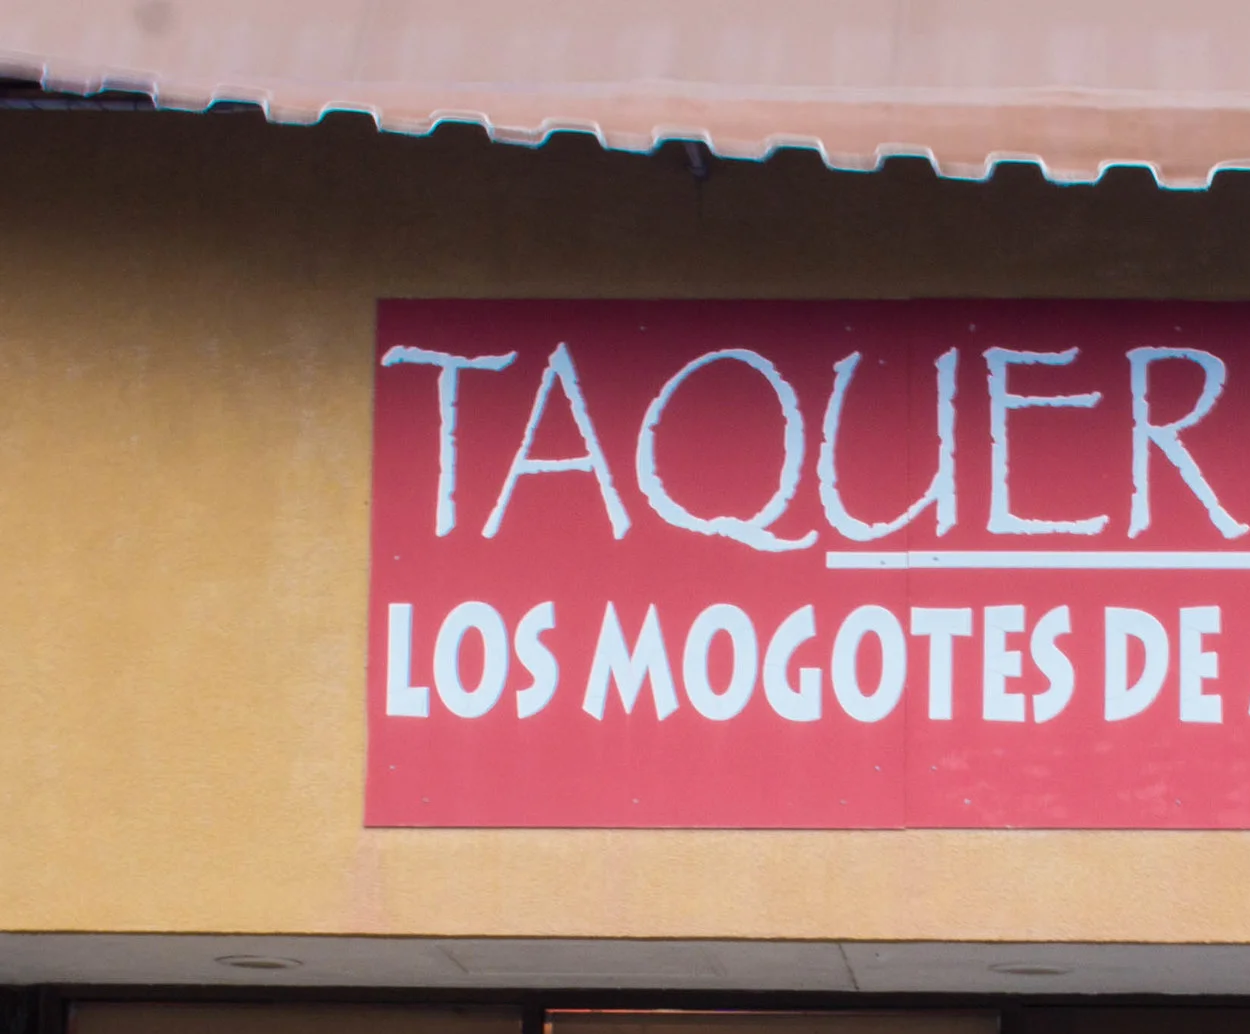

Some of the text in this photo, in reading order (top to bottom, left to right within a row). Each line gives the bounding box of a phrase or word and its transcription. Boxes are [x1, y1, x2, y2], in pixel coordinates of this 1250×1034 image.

[386, 601, 559, 719] LOS
[582, 601, 1075, 724] MOGOTES
[1104, 606, 1223, 724] DE
